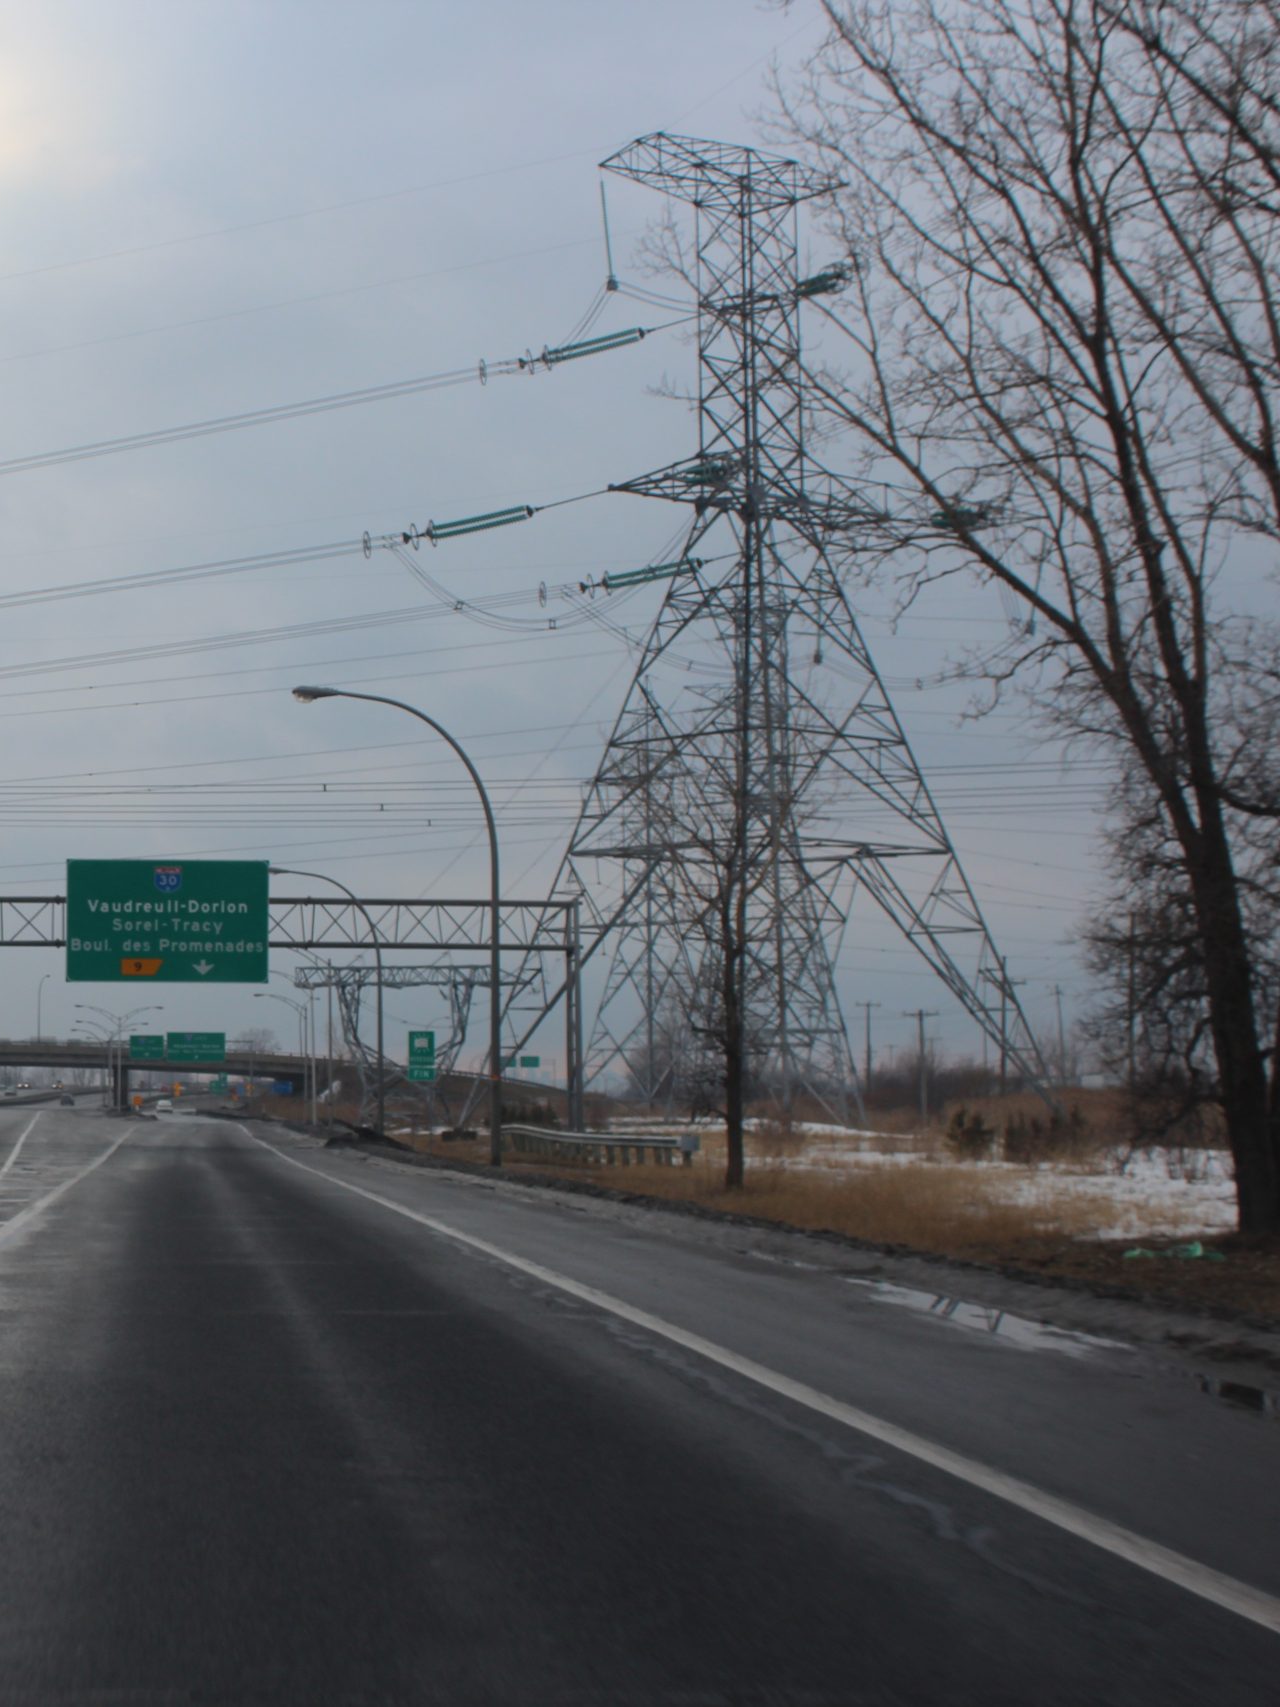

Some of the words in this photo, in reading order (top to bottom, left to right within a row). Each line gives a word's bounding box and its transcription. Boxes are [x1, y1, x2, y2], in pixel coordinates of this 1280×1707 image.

[159, 875, 177, 886] 30
[87, 899, 248, 913] Vaudreuil-Dorion
[112, 918, 223, 934] Sorel-Tracy
[70, 938, 112, 952] Boul.
[122, 938, 150, 952] des
[159, 938, 264, 952] Promenades
[133, 961, 142, 972] 9
